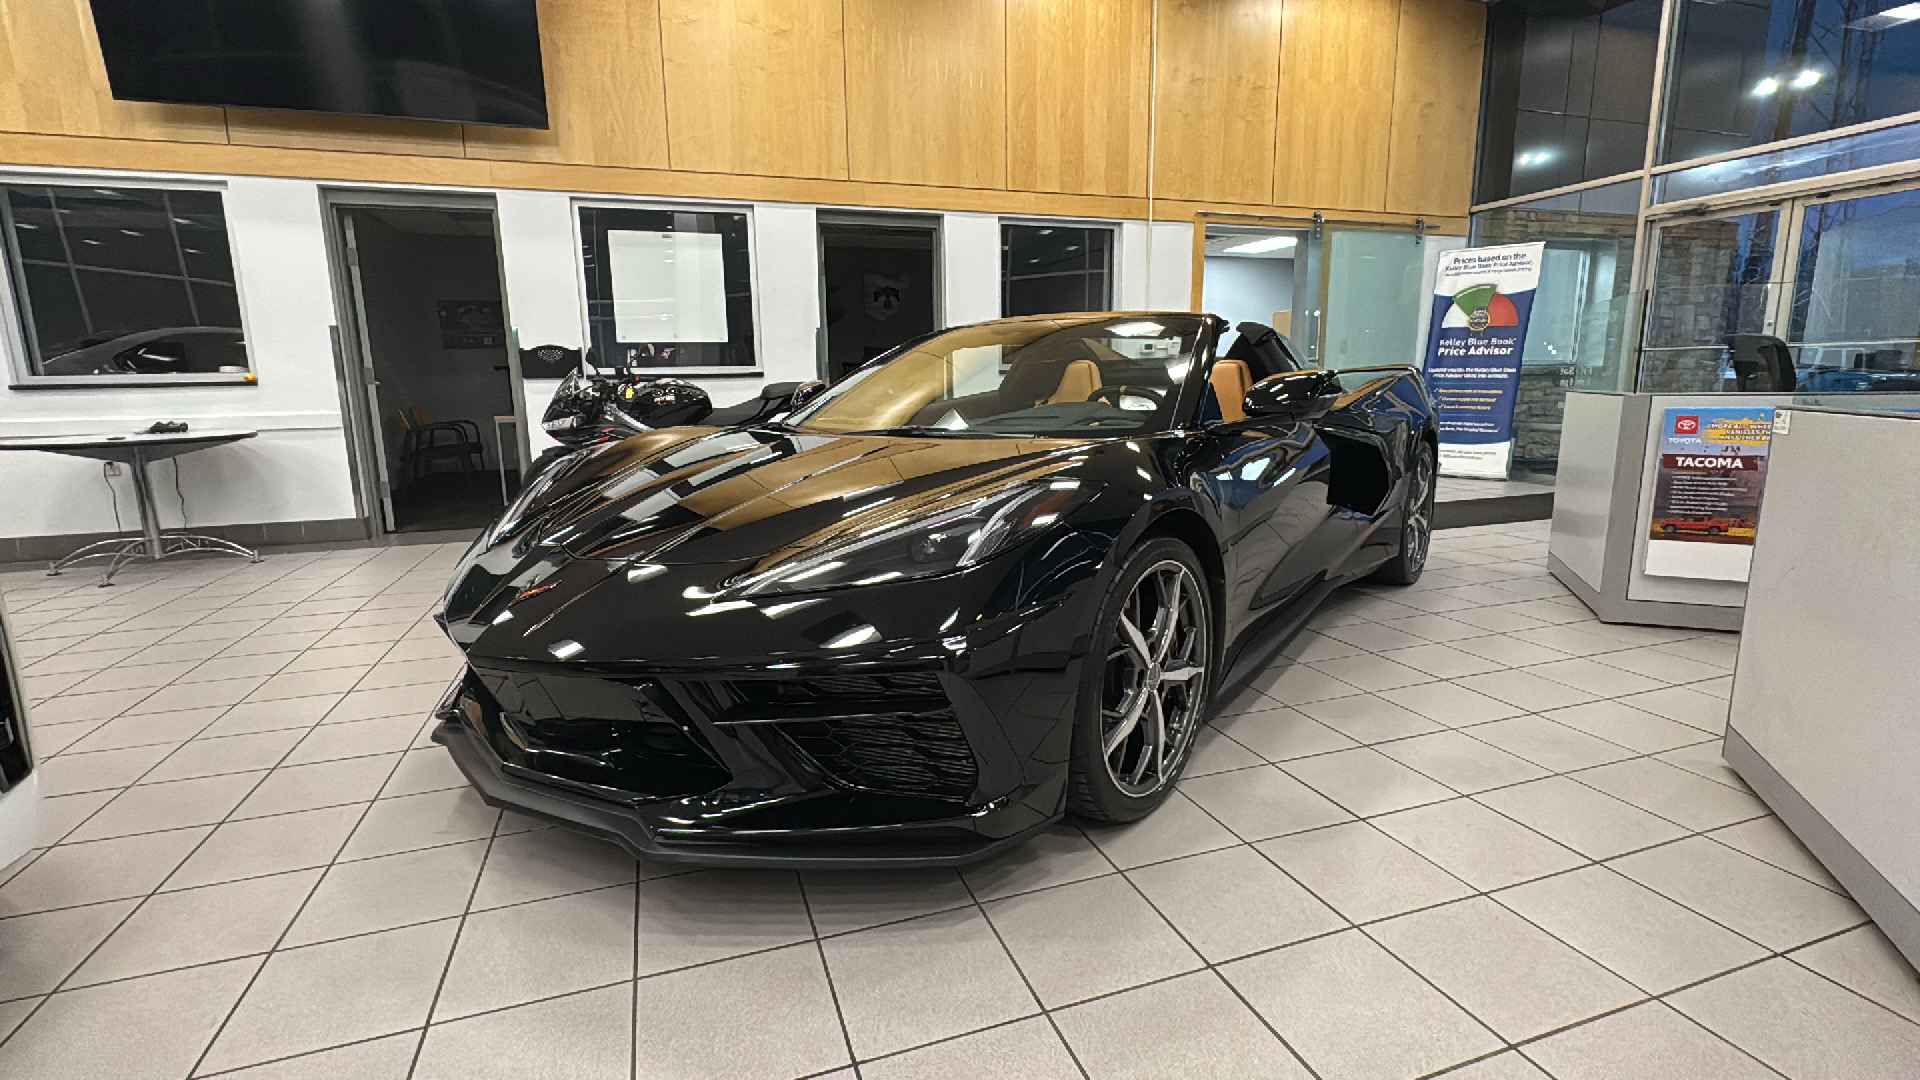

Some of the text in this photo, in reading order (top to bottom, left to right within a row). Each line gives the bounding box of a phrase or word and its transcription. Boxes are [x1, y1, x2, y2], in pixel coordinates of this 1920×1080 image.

[1453, 257, 1476, 265] Prices
[1477, 254, 1500, 263] based
[1513, 252, 1527, 260] the
[1439, 337, 1466, 348] Kelley
[1467, 337, 1489, 346] Blue
[1437, 345, 1514, 357] Price Advisor
[1668, 437, 1702, 445] TOYOTA
[1675, 456, 1743, 469] TACOMA
